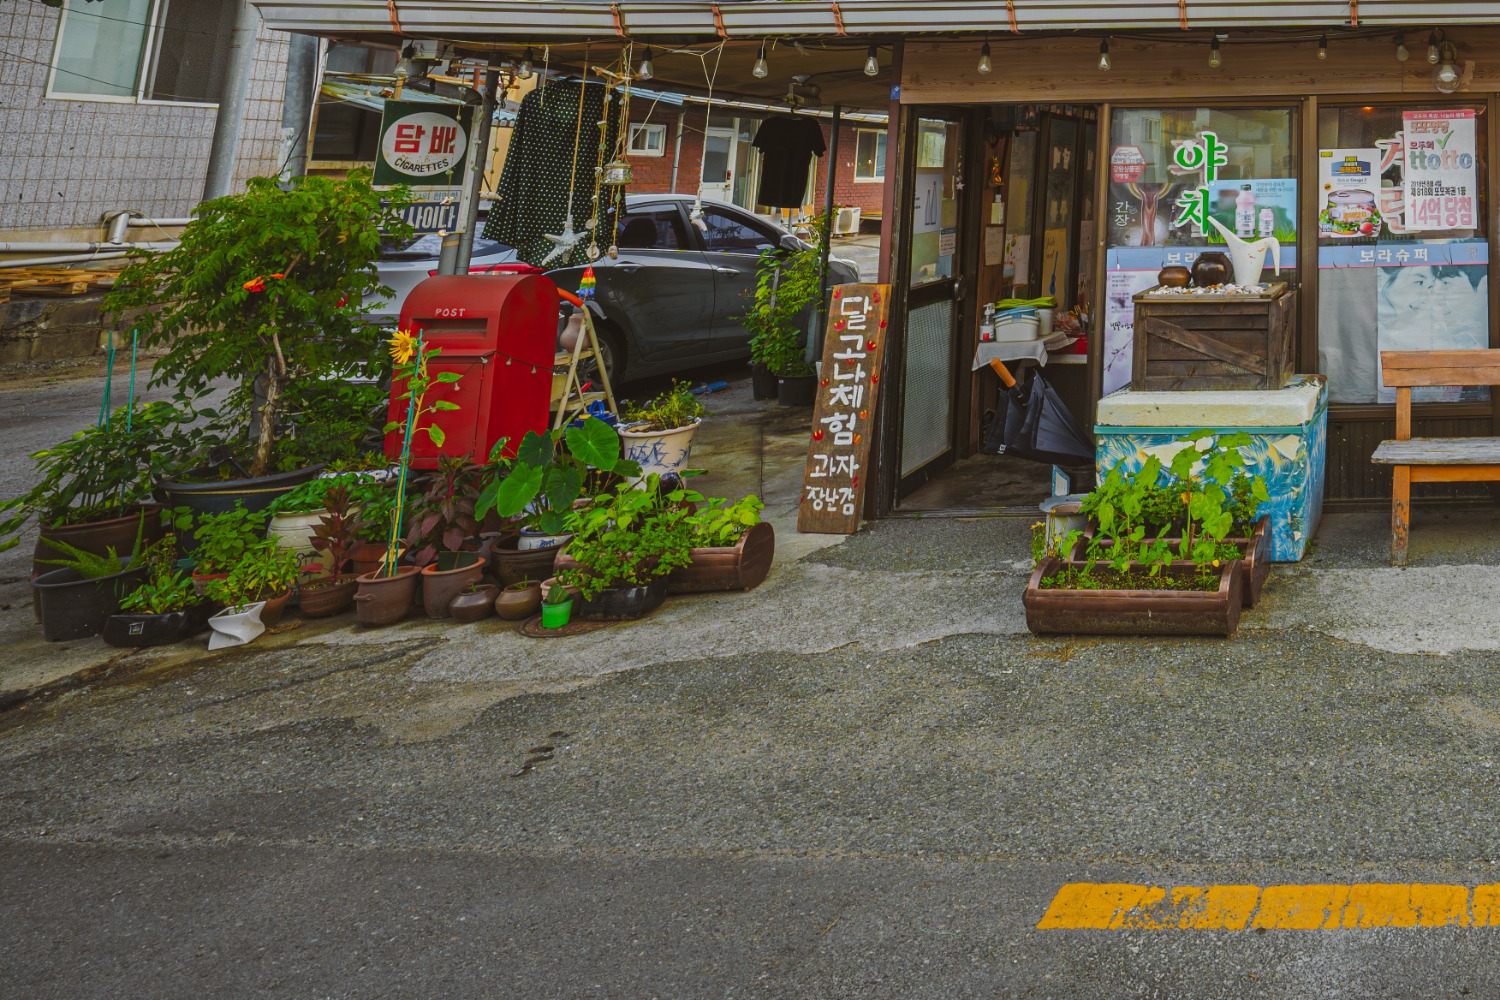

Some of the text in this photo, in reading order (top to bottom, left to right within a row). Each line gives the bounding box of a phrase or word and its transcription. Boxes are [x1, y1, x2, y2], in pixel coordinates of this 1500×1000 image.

[394, 124, 457, 154] 담배
[394, 157, 450, 173] CIGARETTES
[1411, 196, 1473, 226] 14억 당첨
[1360, 247, 1428, 263] 보라슈퍼
[435, 308, 467, 317] POST
[810, 454, 859, 478] 과자
[806, 485, 856, 516] 장난감
